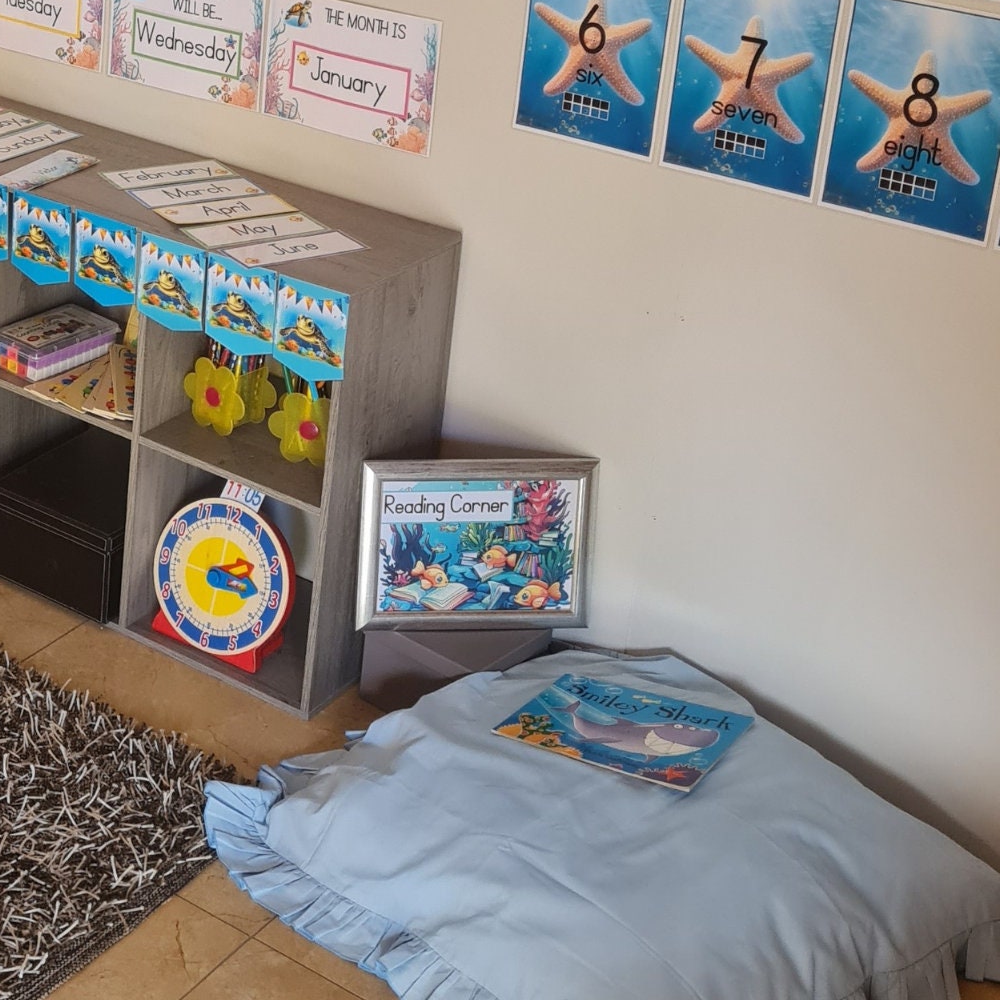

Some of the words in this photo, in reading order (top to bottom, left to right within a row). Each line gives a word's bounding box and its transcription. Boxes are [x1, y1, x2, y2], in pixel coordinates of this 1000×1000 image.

[325, 7, 344, 26] THE
[347, 13, 389, 36] MONTH
[392, 22, 406, 39] IS
[579, 4, 606, 54] 6
[137, 18, 237, 73] Wednesday
[741, 36, 768, 89] 7
[310, 56, 387, 107] January
[576, 63, 604, 87] six
[902, 73, 939, 127] 8
[711, 100, 778, 128] seven
[884, 136, 943, 171] eight
[119, 165, 213, 183] February
[162, 184, 231, 199] March
[202, 201, 251, 218] April
[229, 223, 278, 236] May
[272, 243, 318, 256] June
[198, 502, 212, 520] 11
[226, 505, 241, 524] 12
[384, 495, 445, 521] Reading
[450, 494, 509, 514] Corner
[171, 518, 186, 537] 10
[255, 524, 262, 539] 1
[161, 548, 170, 565] 9
[270, 557, 279, 575] 2
[162, 583, 171, 598] 8
[269, 592, 278, 608] 3
[175, 612, 184, 627] 7
[253, 621, 262, 638] 4
[200, 632, 208, 648] 6
[228, 635, 237, 651] 5
[566, 682, 649, 715] Smiley
[655, 706, 736, 731] Shark
